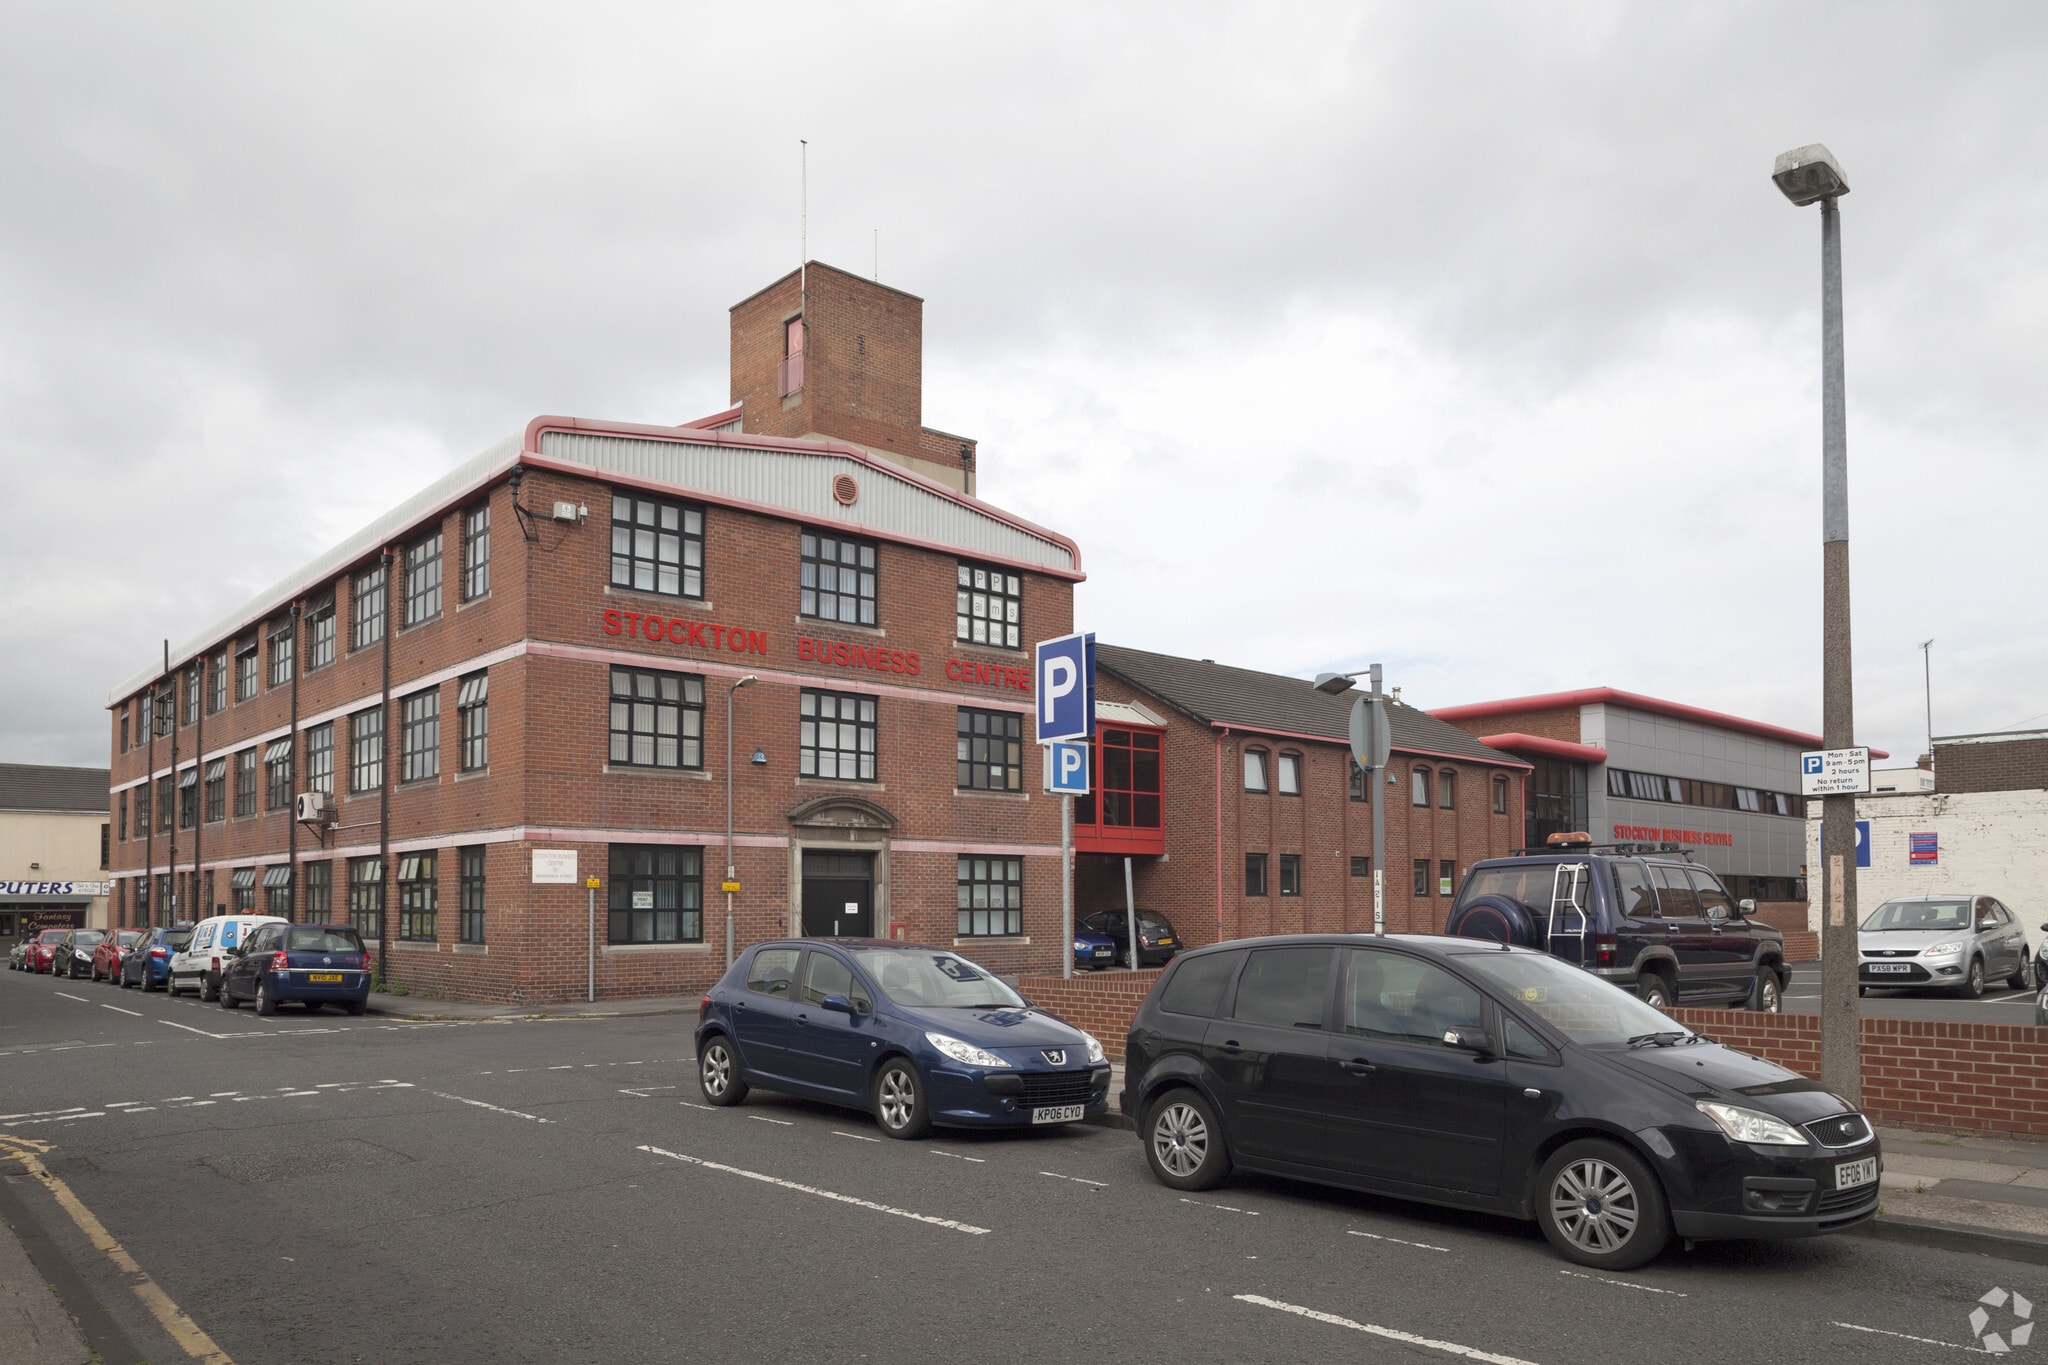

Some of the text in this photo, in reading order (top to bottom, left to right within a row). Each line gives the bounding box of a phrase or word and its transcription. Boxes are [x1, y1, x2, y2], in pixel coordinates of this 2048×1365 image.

[603, 608, 1031, 690] STOCKTON BUSINESS CENTRE
[1044, 655, 1077, 724] P
[1061, 748, 1081, 785] P
[1808, 758, 1820, 773] P
[1614, 824, 1733, 846] STOCKTON BUSINESS CENTRE
[28, 922, 75, 930] Computers
[33, 912, 72, 921] Fantasy
[1037, 1106, 1080, 1120] KP06 CYO
[1840, 1164, 1860, 1186] EF06
